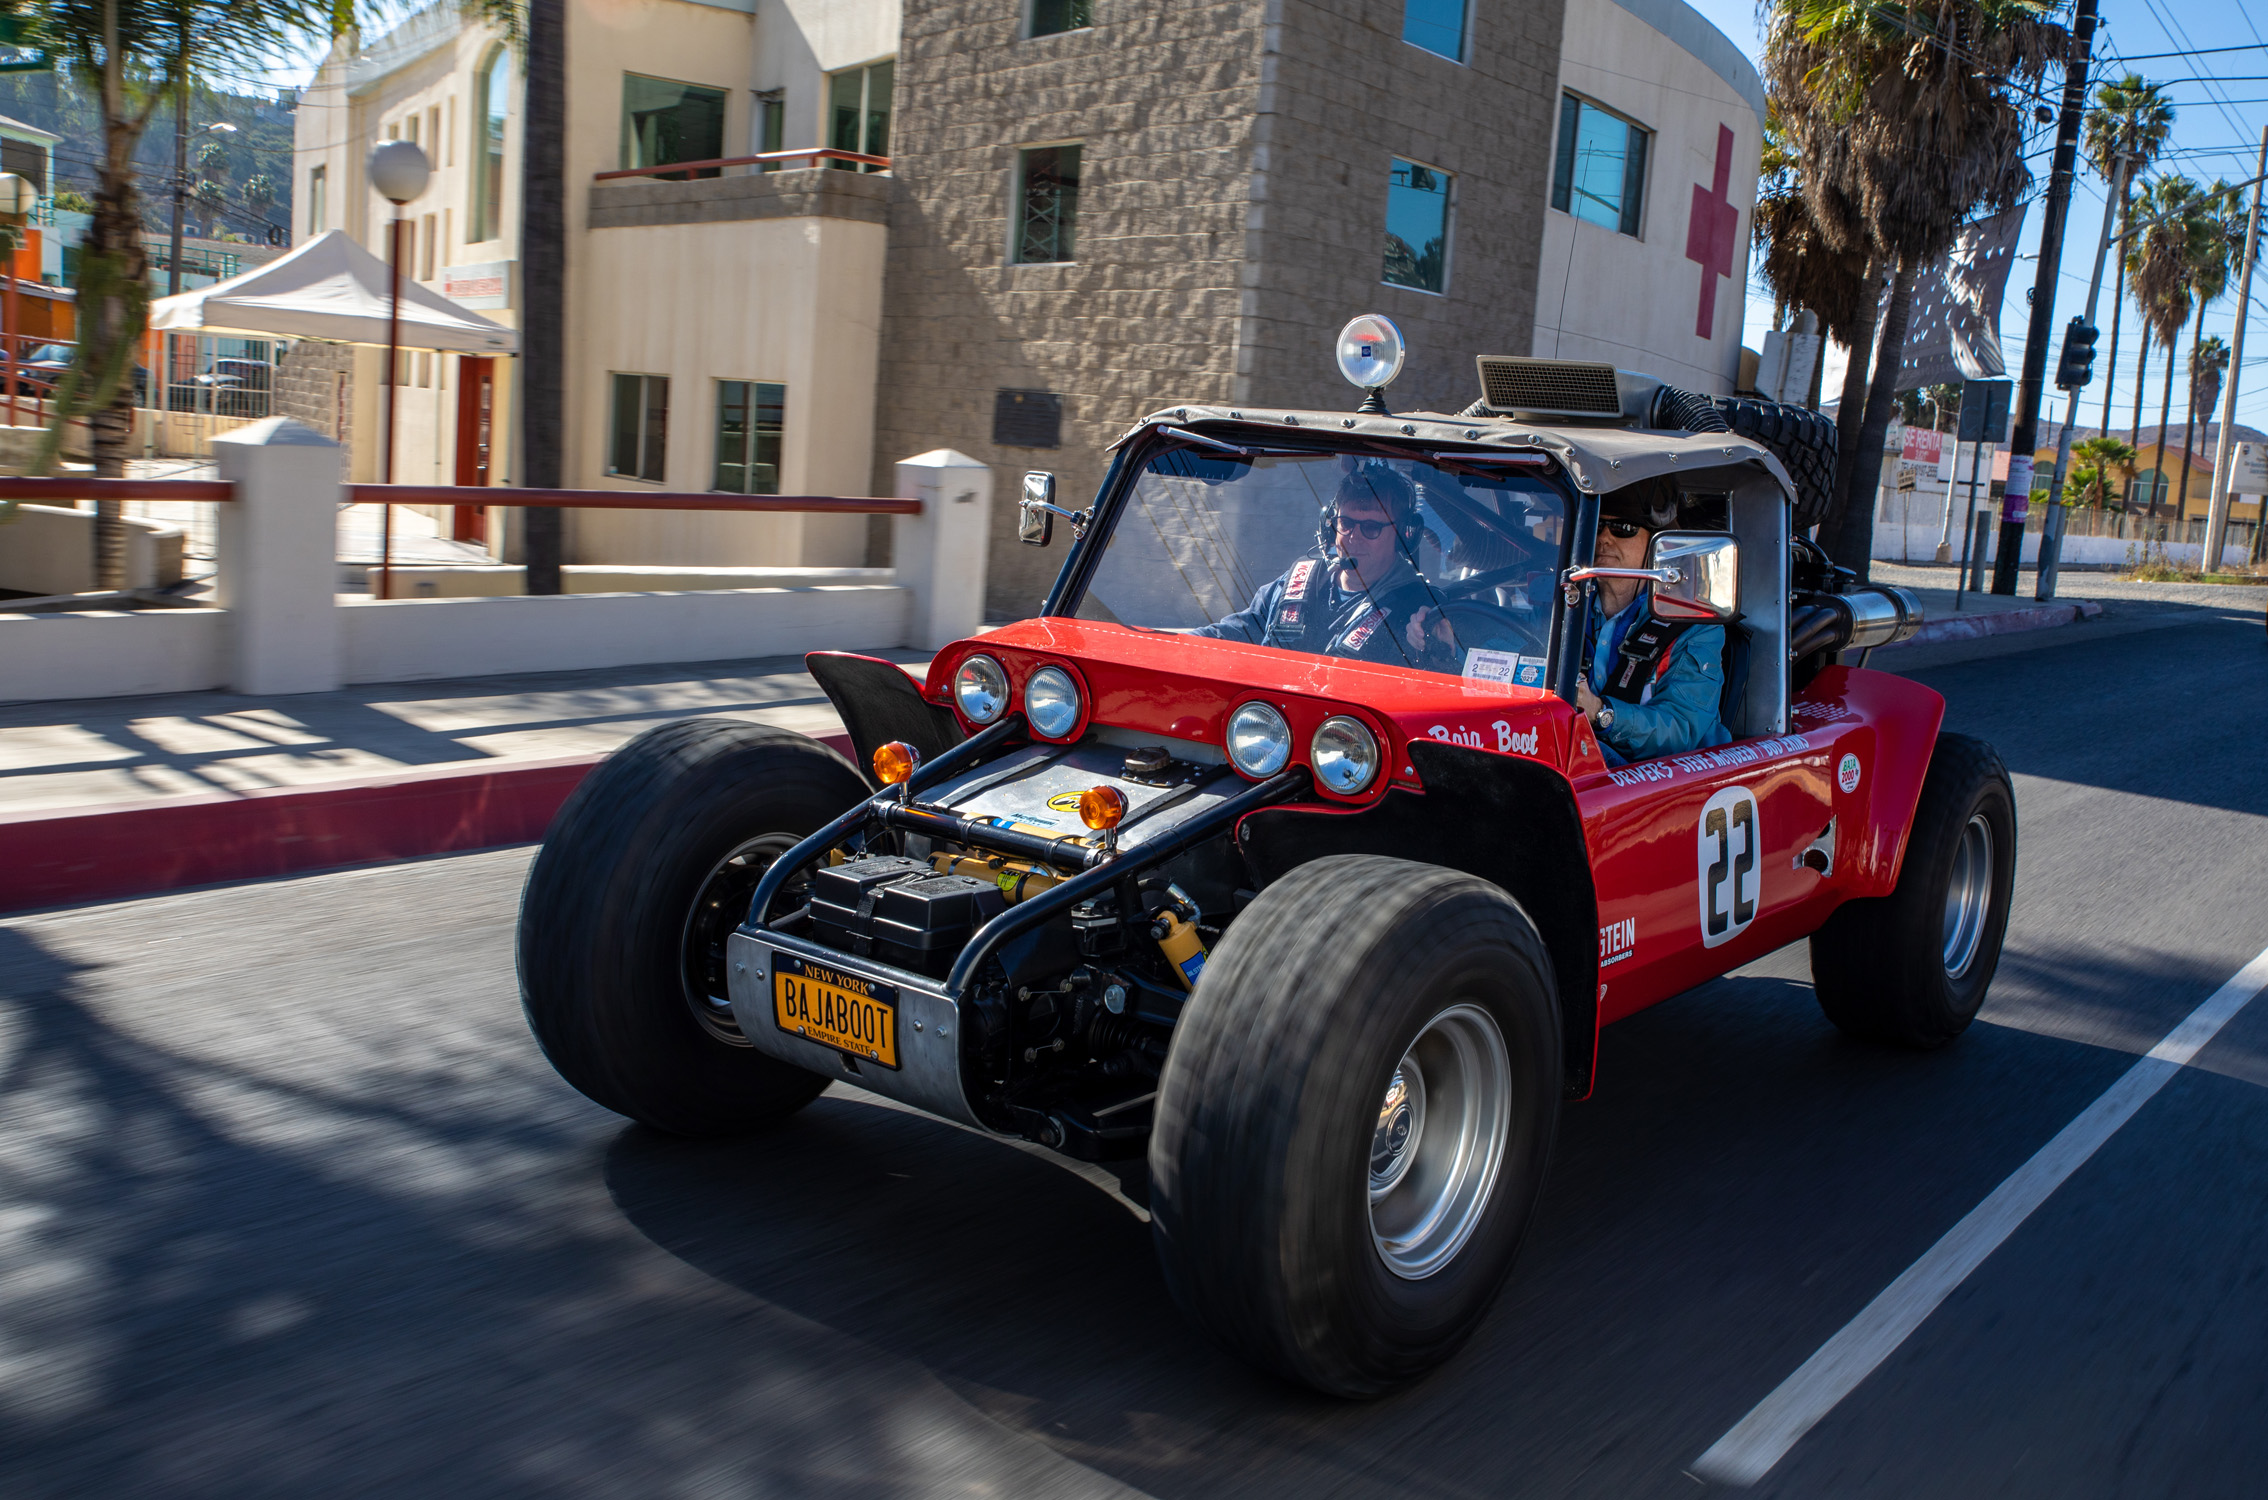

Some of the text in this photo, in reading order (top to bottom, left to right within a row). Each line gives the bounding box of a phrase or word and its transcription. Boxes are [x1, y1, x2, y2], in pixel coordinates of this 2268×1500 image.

[1904, 427, 1942, 451] SE RENTA
[1498, 667, 1511, 677] 22
[1491, 720, 1539, 756] Boot
[1607, 760, 1674, 788] DRIVERS
[1672, 752, 1715, 774] STEVE
[1705, 744, 1759, 772] McQUEEN
[1756, 739, 1784, 758] BUD
[1841, 769, 1855, 784] 2000
[1705, 799, 1754, 937] 22
[1600, 949, 1633, 968] ABSORBERS
[804, 963, 869, 996] NEW YORK
[785, 977, 889, 1049] BAJABOOT
[807, 1026, 872, 1056] EMPIRE STATE
